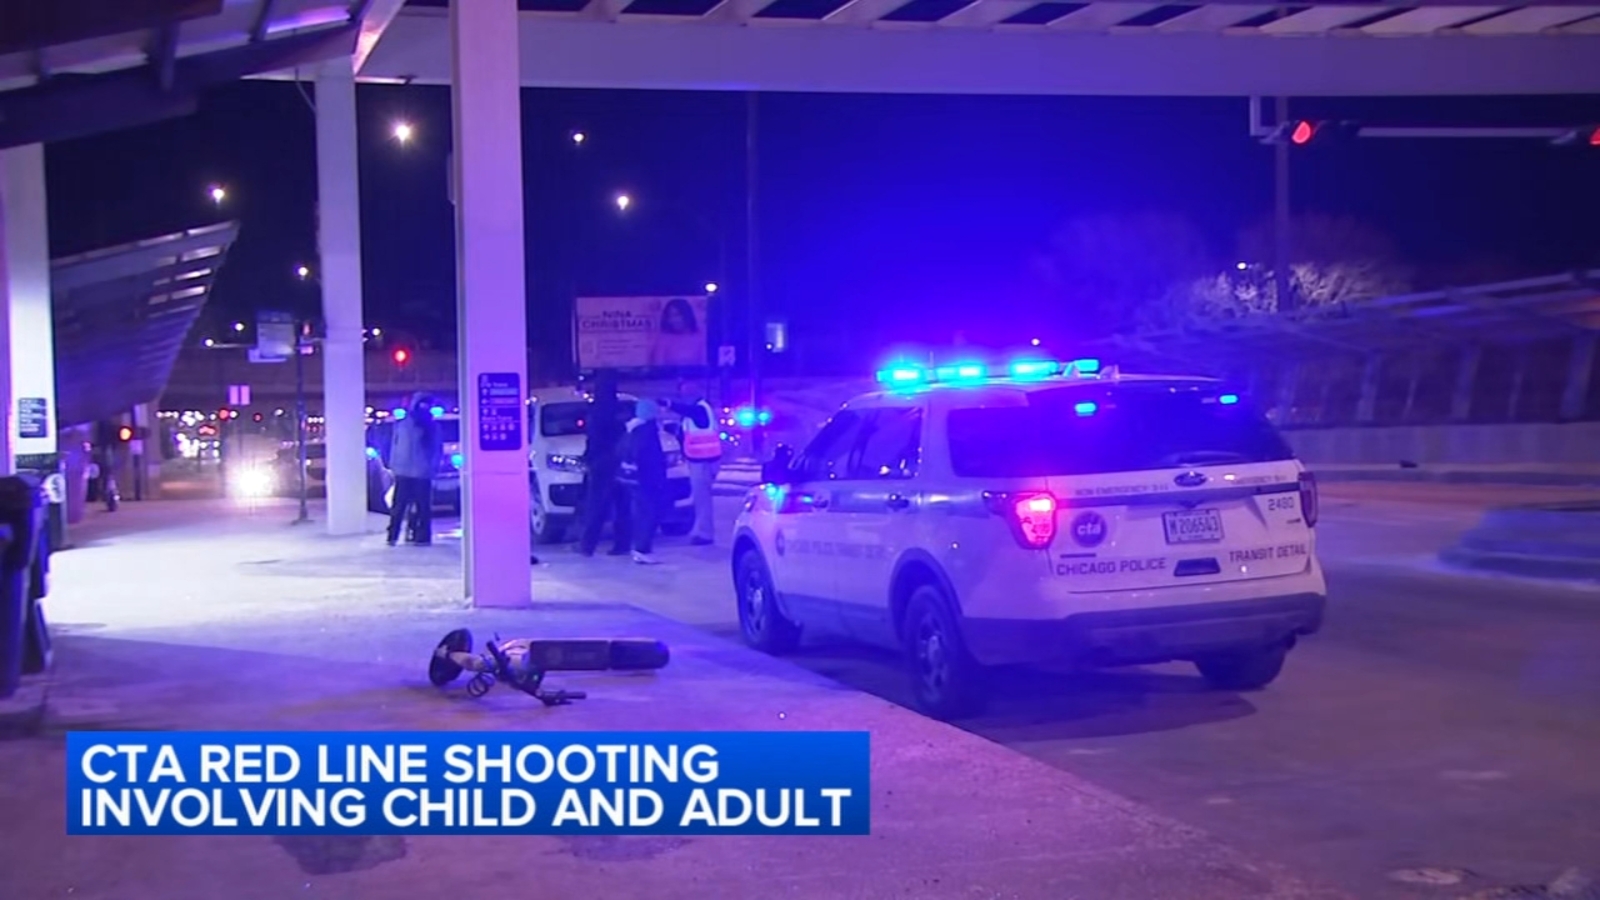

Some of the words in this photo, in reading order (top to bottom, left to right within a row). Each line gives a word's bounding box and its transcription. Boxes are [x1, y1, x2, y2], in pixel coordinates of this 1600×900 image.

[581, 319, 652, 329] CHRISTMAS
[1077, 521, 1102, 536] cta
[1229, 547, 1274, 562] TRANSIT
[1276, 543, 1307, 559] DETAIL
[1056, 560, 1117, 576] CHICAGO
[1120, 557, 1167, 573] POLICE
